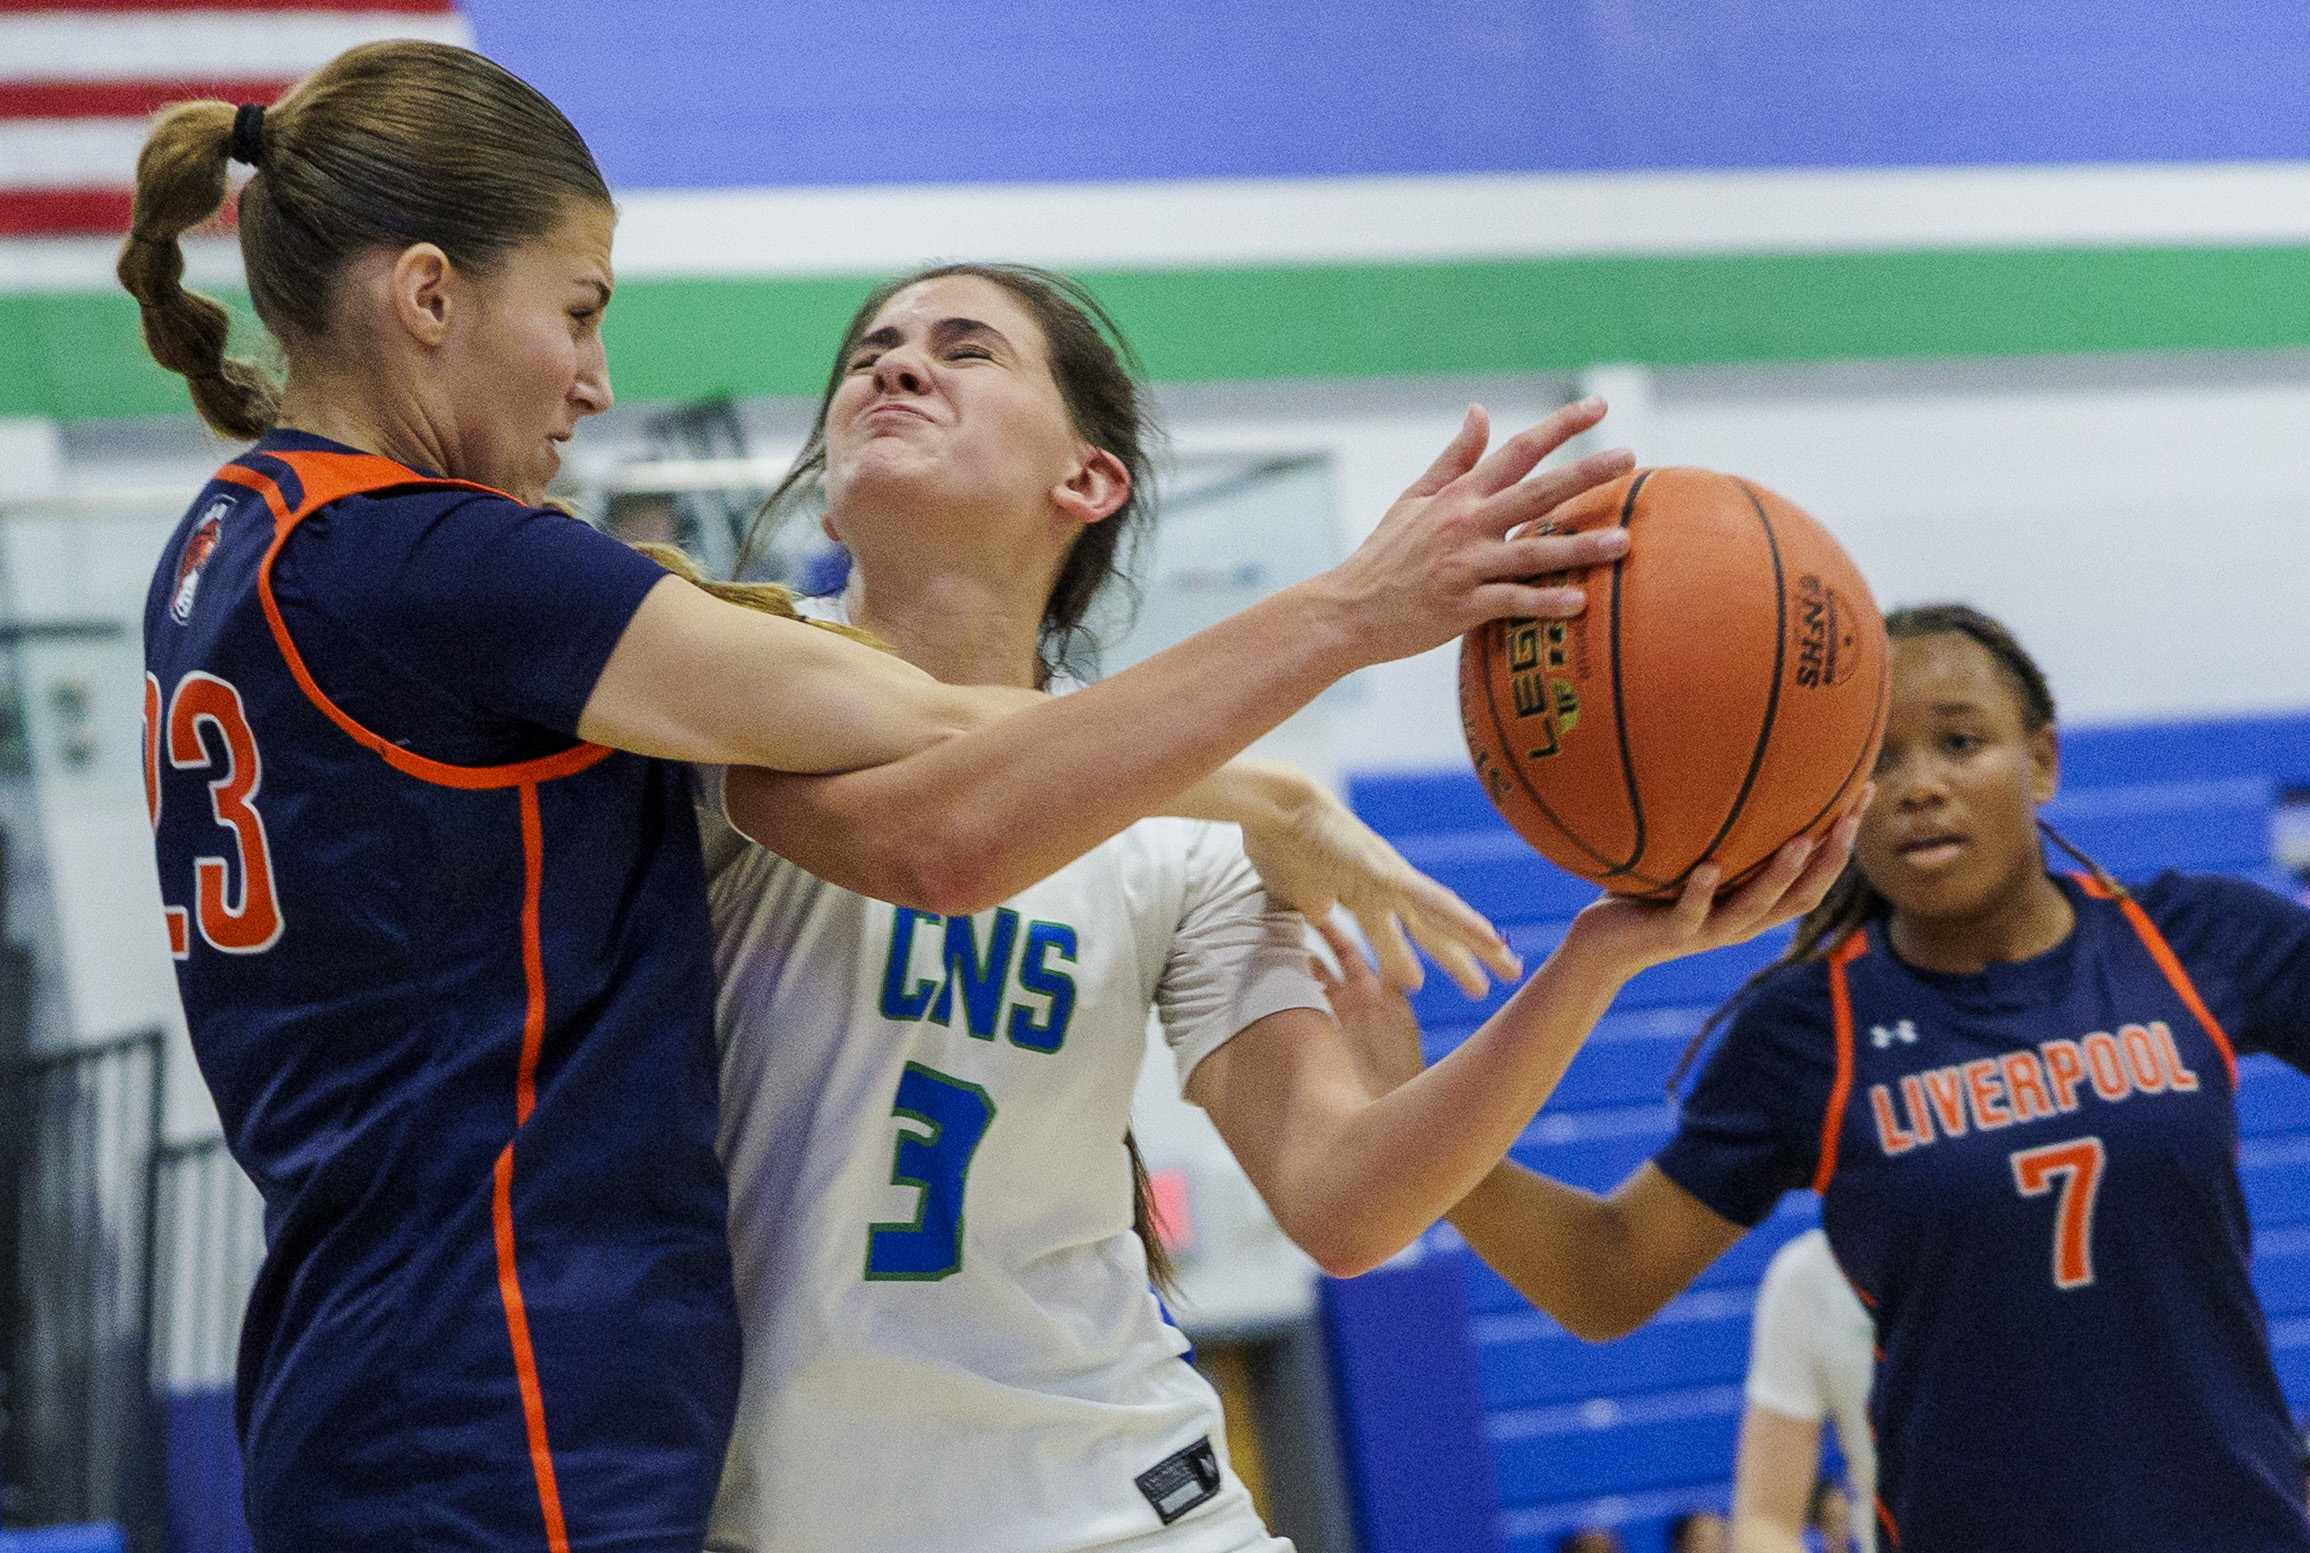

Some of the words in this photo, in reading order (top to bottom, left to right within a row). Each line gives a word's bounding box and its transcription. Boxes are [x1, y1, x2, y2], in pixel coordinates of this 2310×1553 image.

[1507, 616, 1559, 758] LEG
[879, 905, 1078, 1055] CNS
[1869, 1020, 2200, 1156] LIVERPOOL
[863, 1060, 998, 1282] 3
[2010, 1135, 2106, 1289] 7
